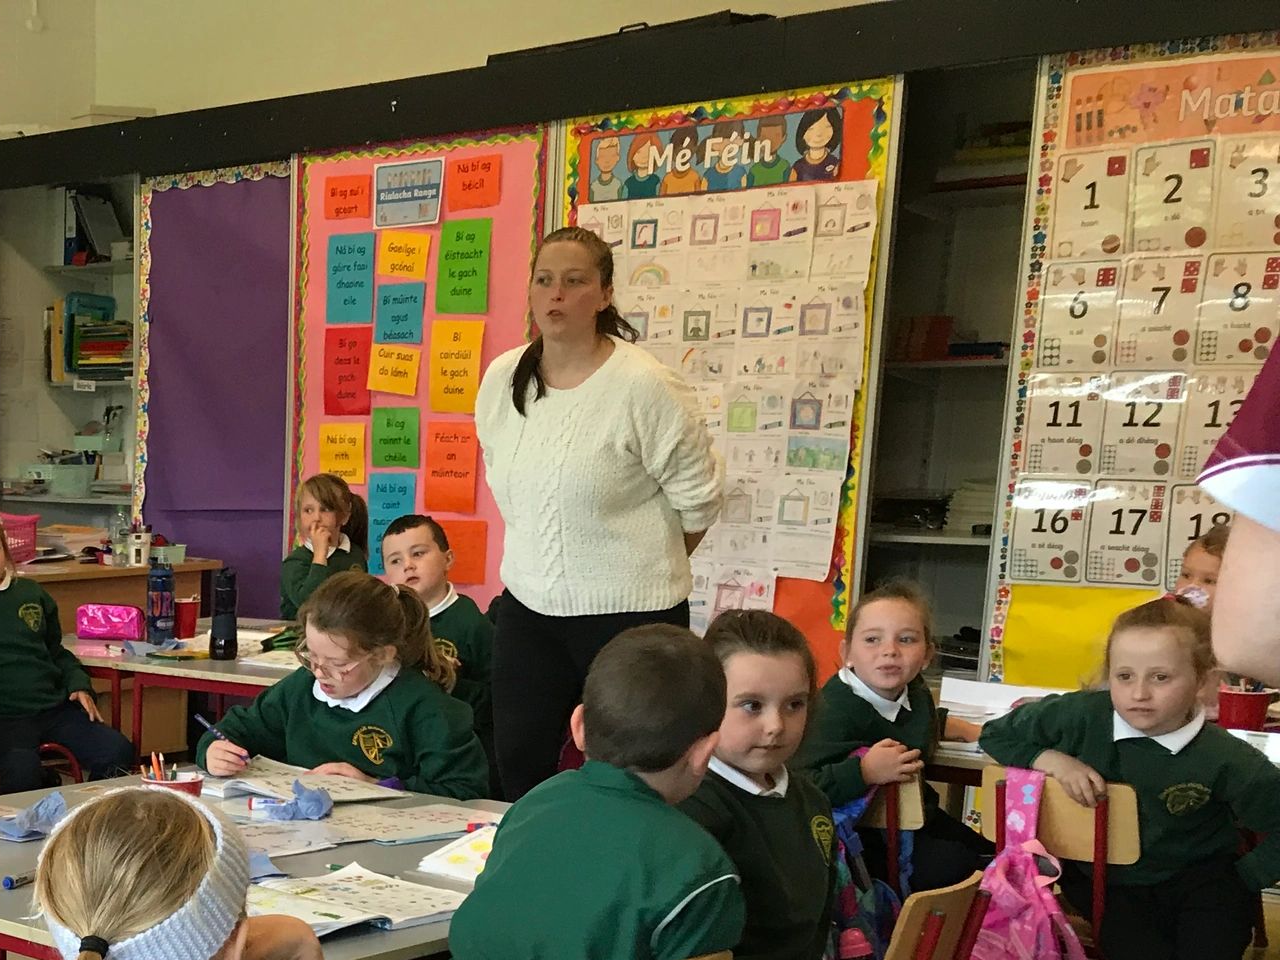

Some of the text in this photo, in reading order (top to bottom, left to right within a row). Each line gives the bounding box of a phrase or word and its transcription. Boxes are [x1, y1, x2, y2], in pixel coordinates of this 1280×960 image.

[1178, 86, 1280, 122] Mata
[648, 131, 773, 175] Mé Féin
[380, 189, 436, 201] Rialacha Ranga
[1083, 181, 1100, 210] 1
[1163, 174, 1184, 204] 2
[1248, 167, 1269, 198] 3
[466, 233, 475, 242] ag
[458, 269, 477, 280] gach
[450, 288, 472, 296] duine
[1070, 290, 1088, 319] 6
[1151, 286, 1172, 315] 7
[1229, 282, 1252, 312] 8
[450, 369, 468, 380] gach
[444, 386, 464, 394] duine
[1046, 400, 1082, 427] 11
[1122, 401, 1163, 427] 12
[1031, 508, 1069, 534] 16
[1109, 509, 1148, 536] 17
